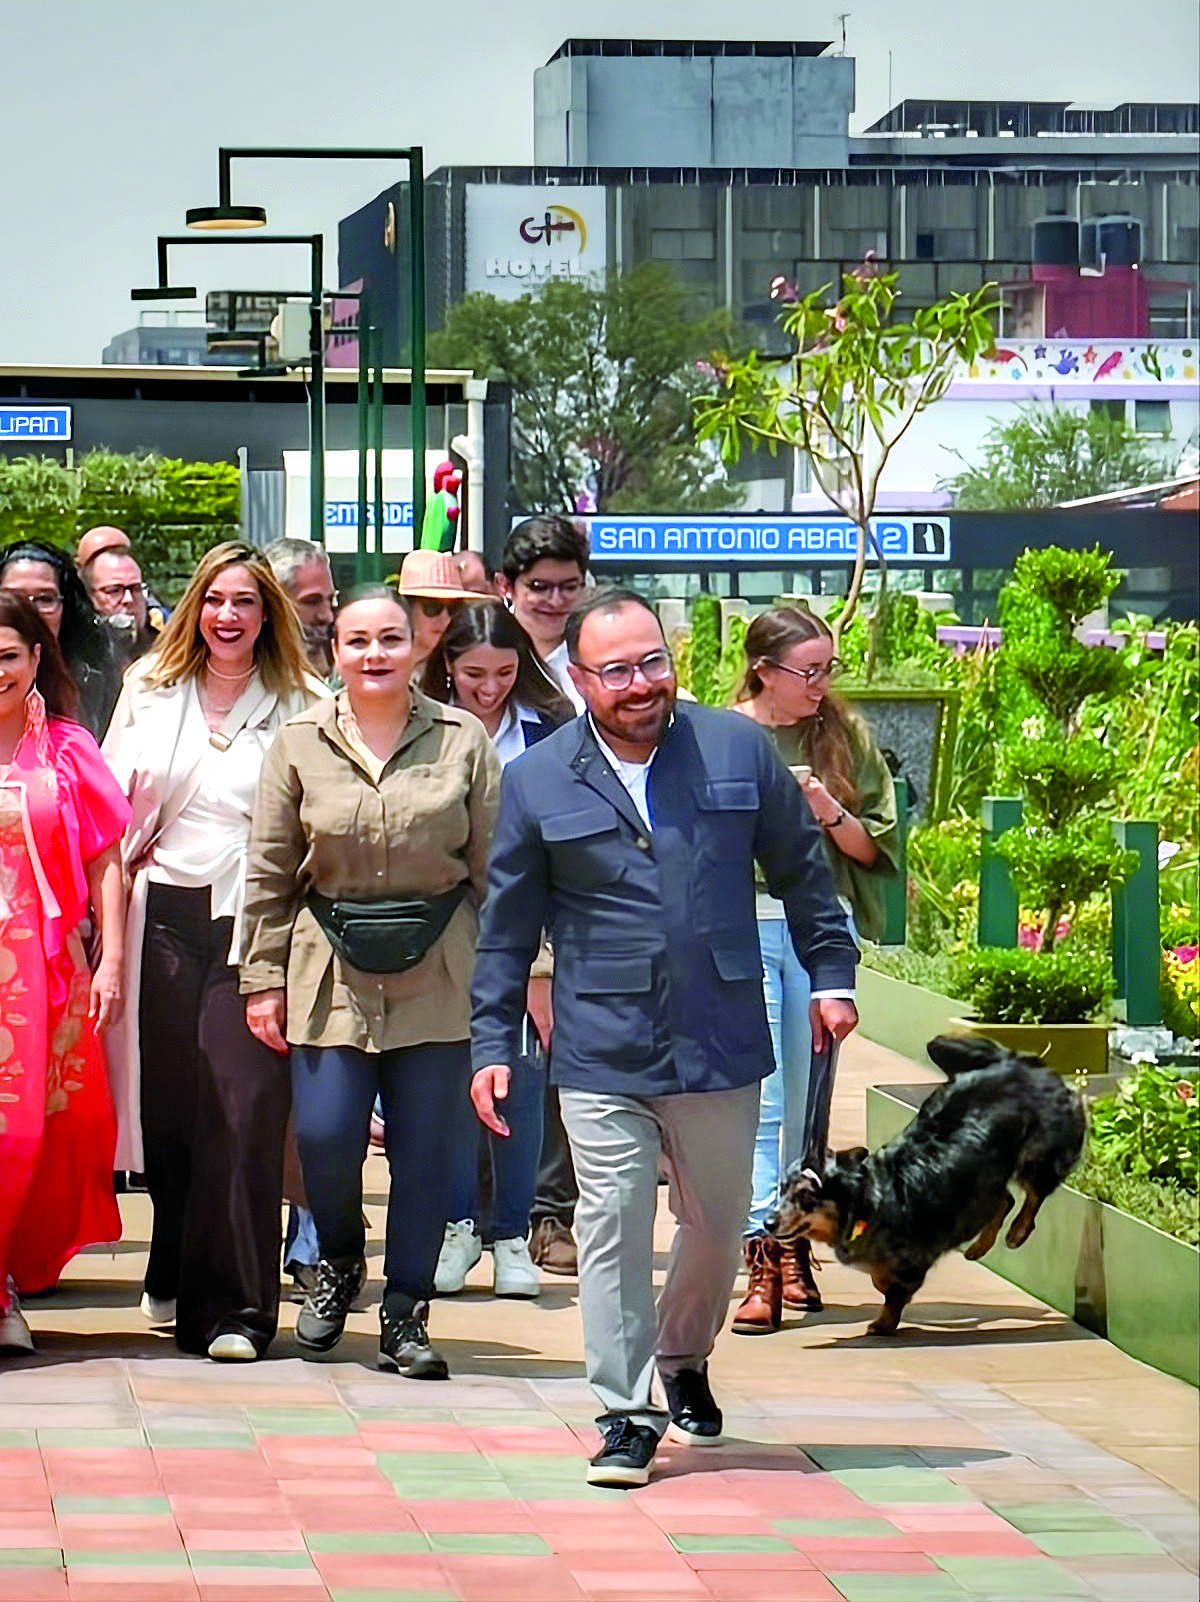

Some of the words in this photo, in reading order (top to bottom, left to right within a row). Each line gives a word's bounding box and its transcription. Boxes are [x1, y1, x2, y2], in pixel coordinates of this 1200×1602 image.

[599, 527, 656, 549] SAN
[664, 527, 780, 549] ANTONIO
[882, 527, 902, 550] 2
